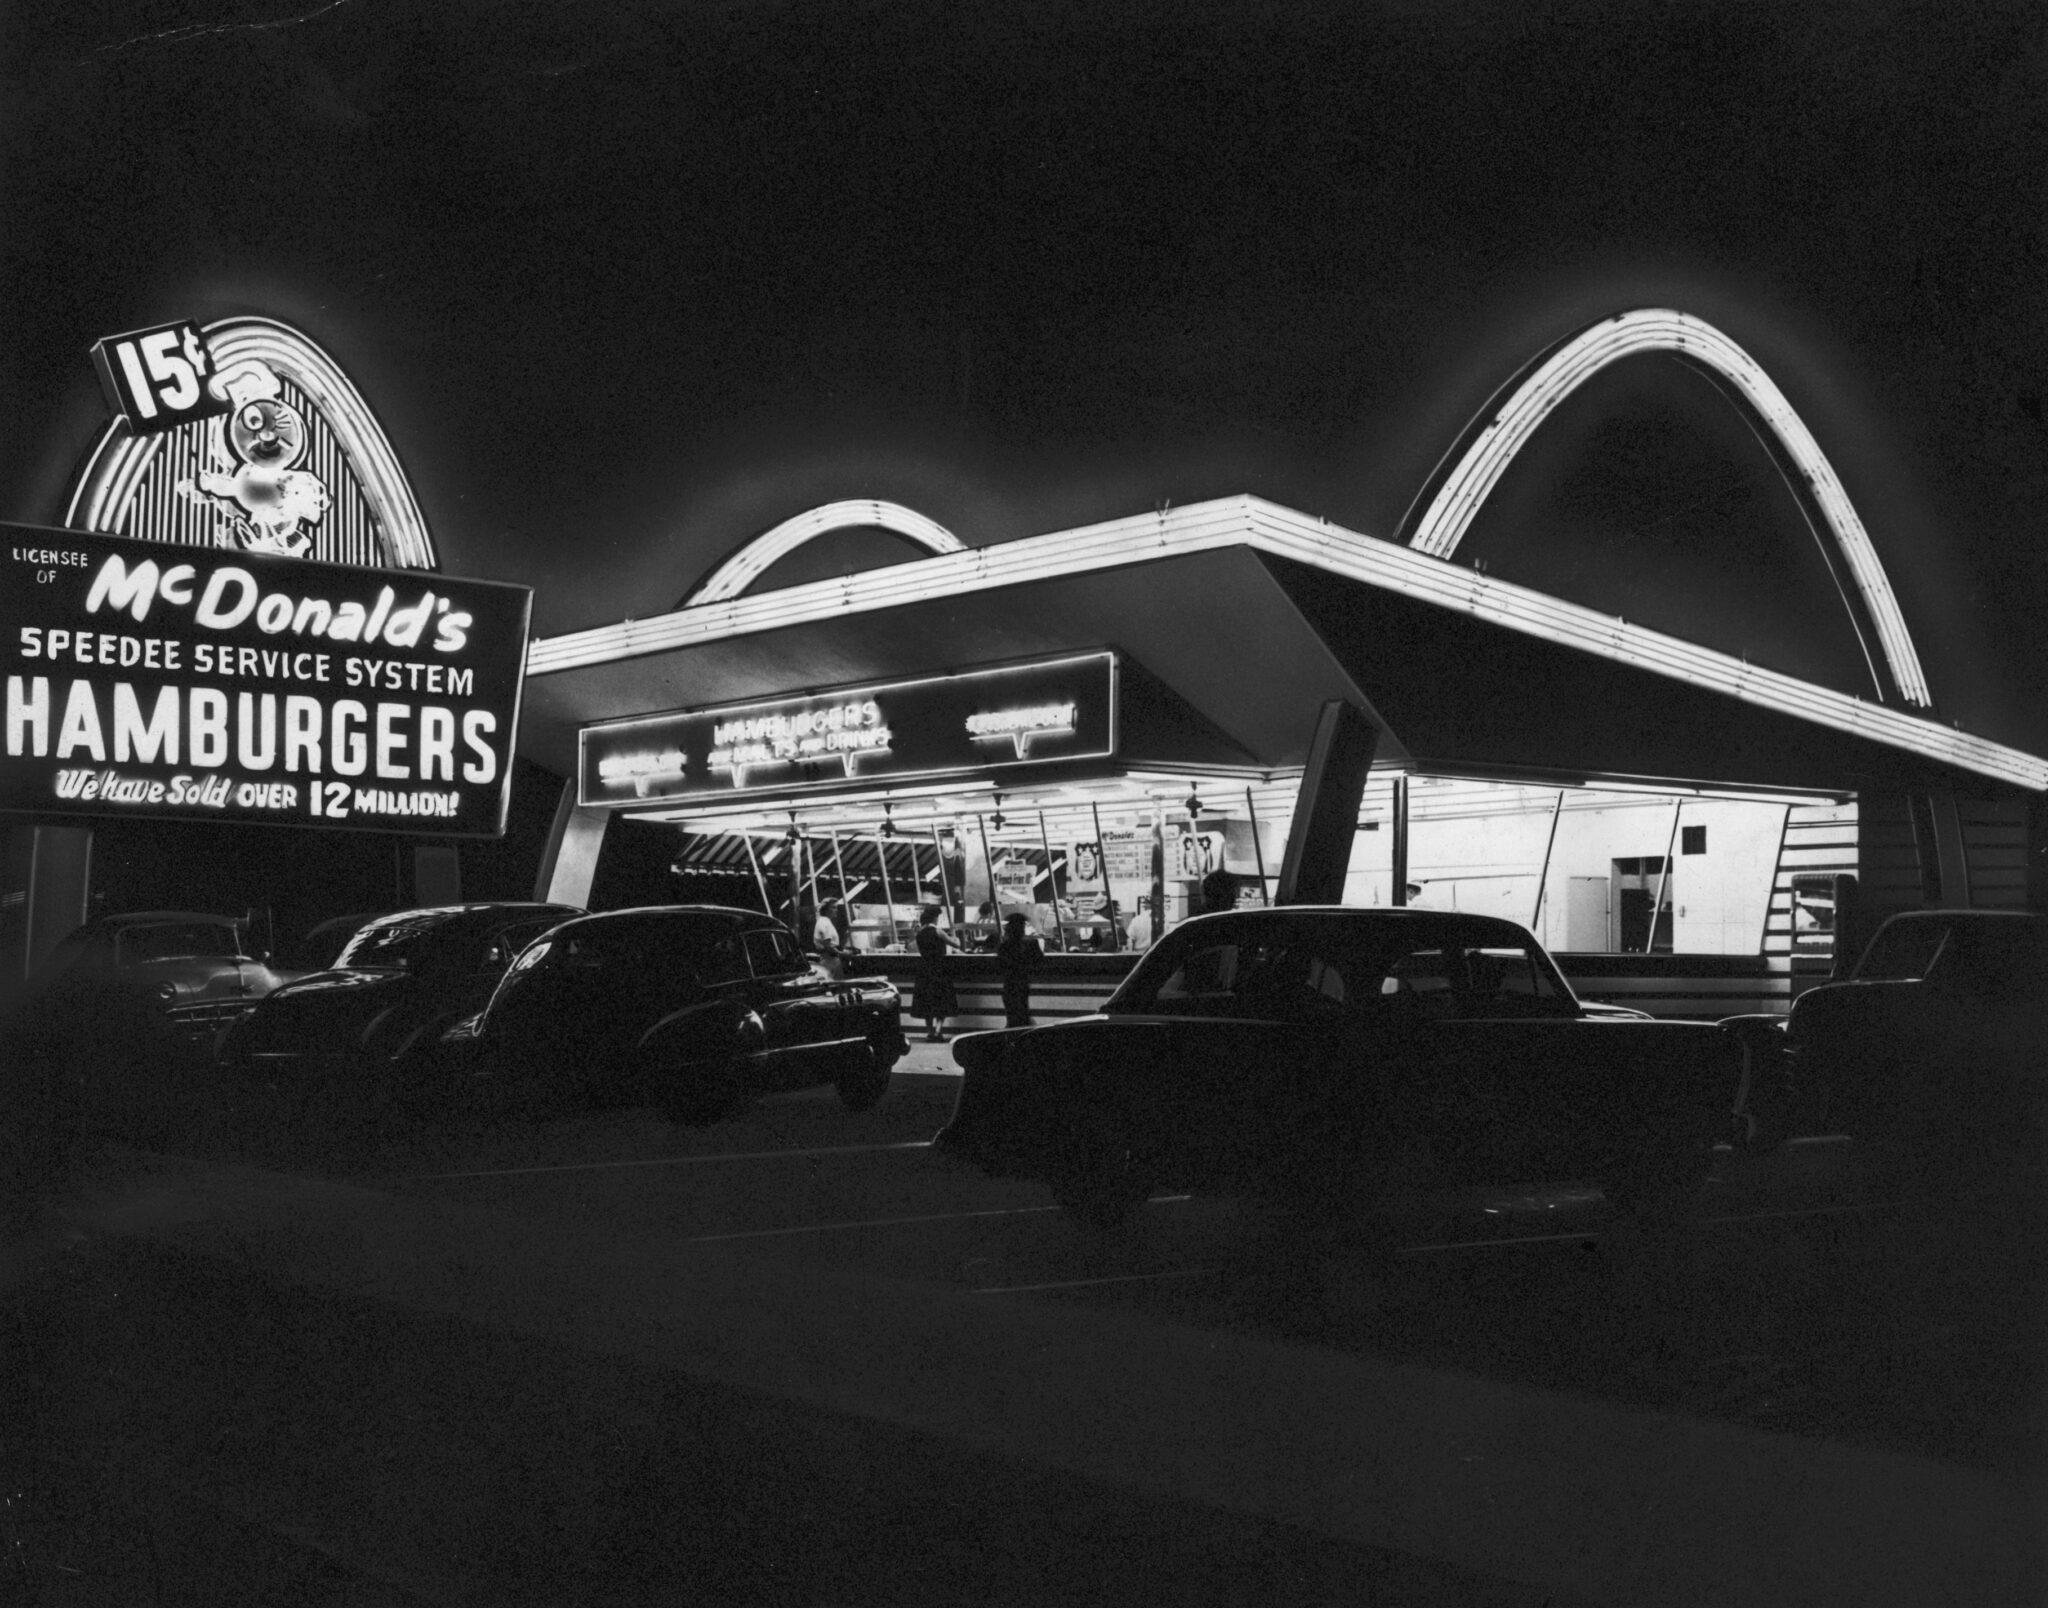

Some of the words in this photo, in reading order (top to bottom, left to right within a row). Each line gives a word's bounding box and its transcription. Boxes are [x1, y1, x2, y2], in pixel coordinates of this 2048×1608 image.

[116, 326, 207, 419] 15¢
[12, 547, 89, 568] LICENSEE
[36, 570, 57, 584] OF
[85, 553, 474, 653] McDonald's
[20, 626, 182, 670] SPEEDEE
[194, 643, 331, 682] SERVICE
[345, 657, 474, 697] SYSTEM
[6, 675, 497, 784] HAMBURGERS
[56, 769, 99, 800] We
[100, 770, 166, 803] have
[166, 775, 231, 809] Sold
[236, 782, 298, 809] OVER
[309, 780, 352, 818] 12
[353, 788, 460, 818] MILLION!
